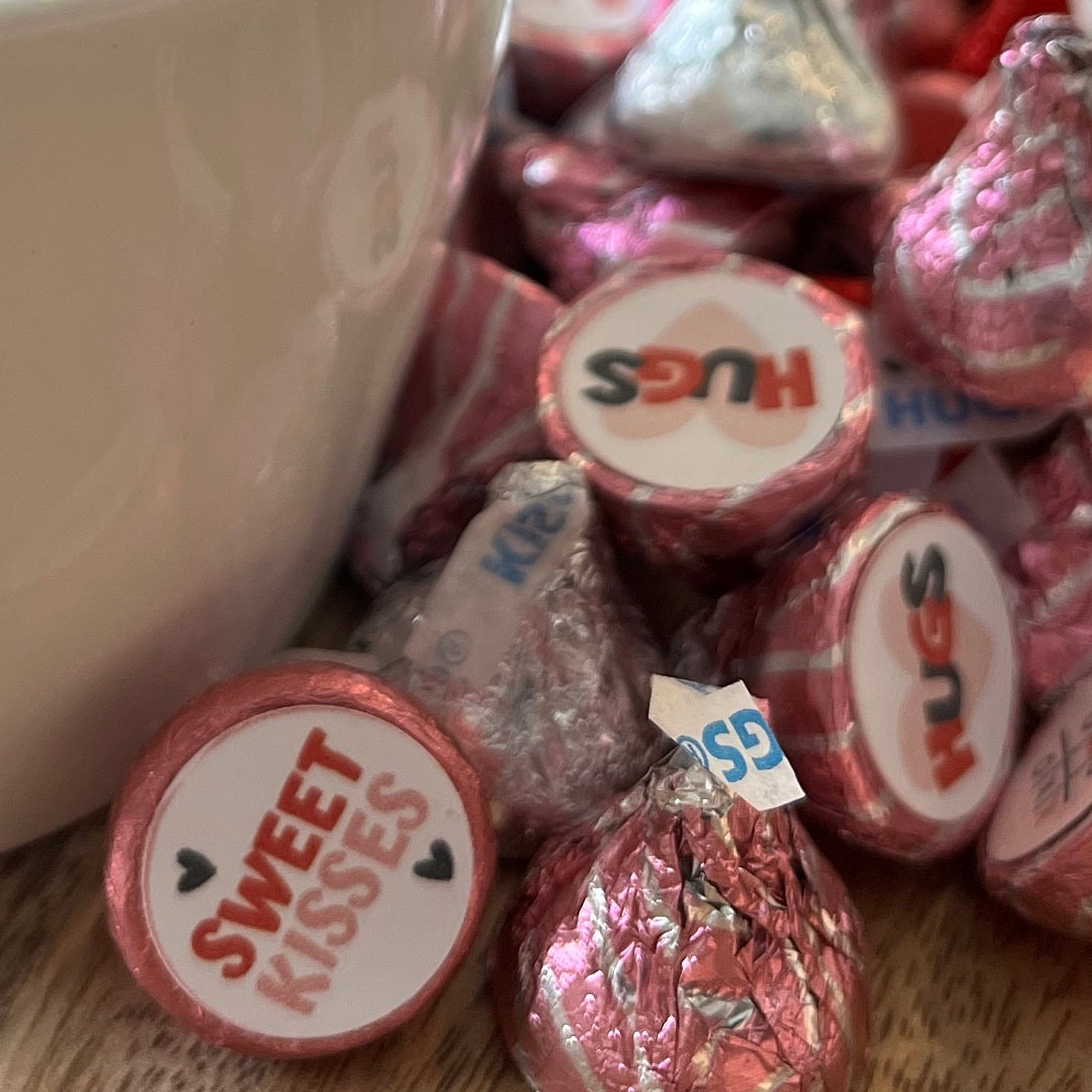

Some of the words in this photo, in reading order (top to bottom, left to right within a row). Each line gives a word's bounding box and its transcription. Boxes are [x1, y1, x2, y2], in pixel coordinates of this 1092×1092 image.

[584, 346, 818, 411] HUGS
[901, 543, 981, 791] HUGS
[191, 726, 364, 981] SWEET
[255, 770, 430, 1016] KISSES
